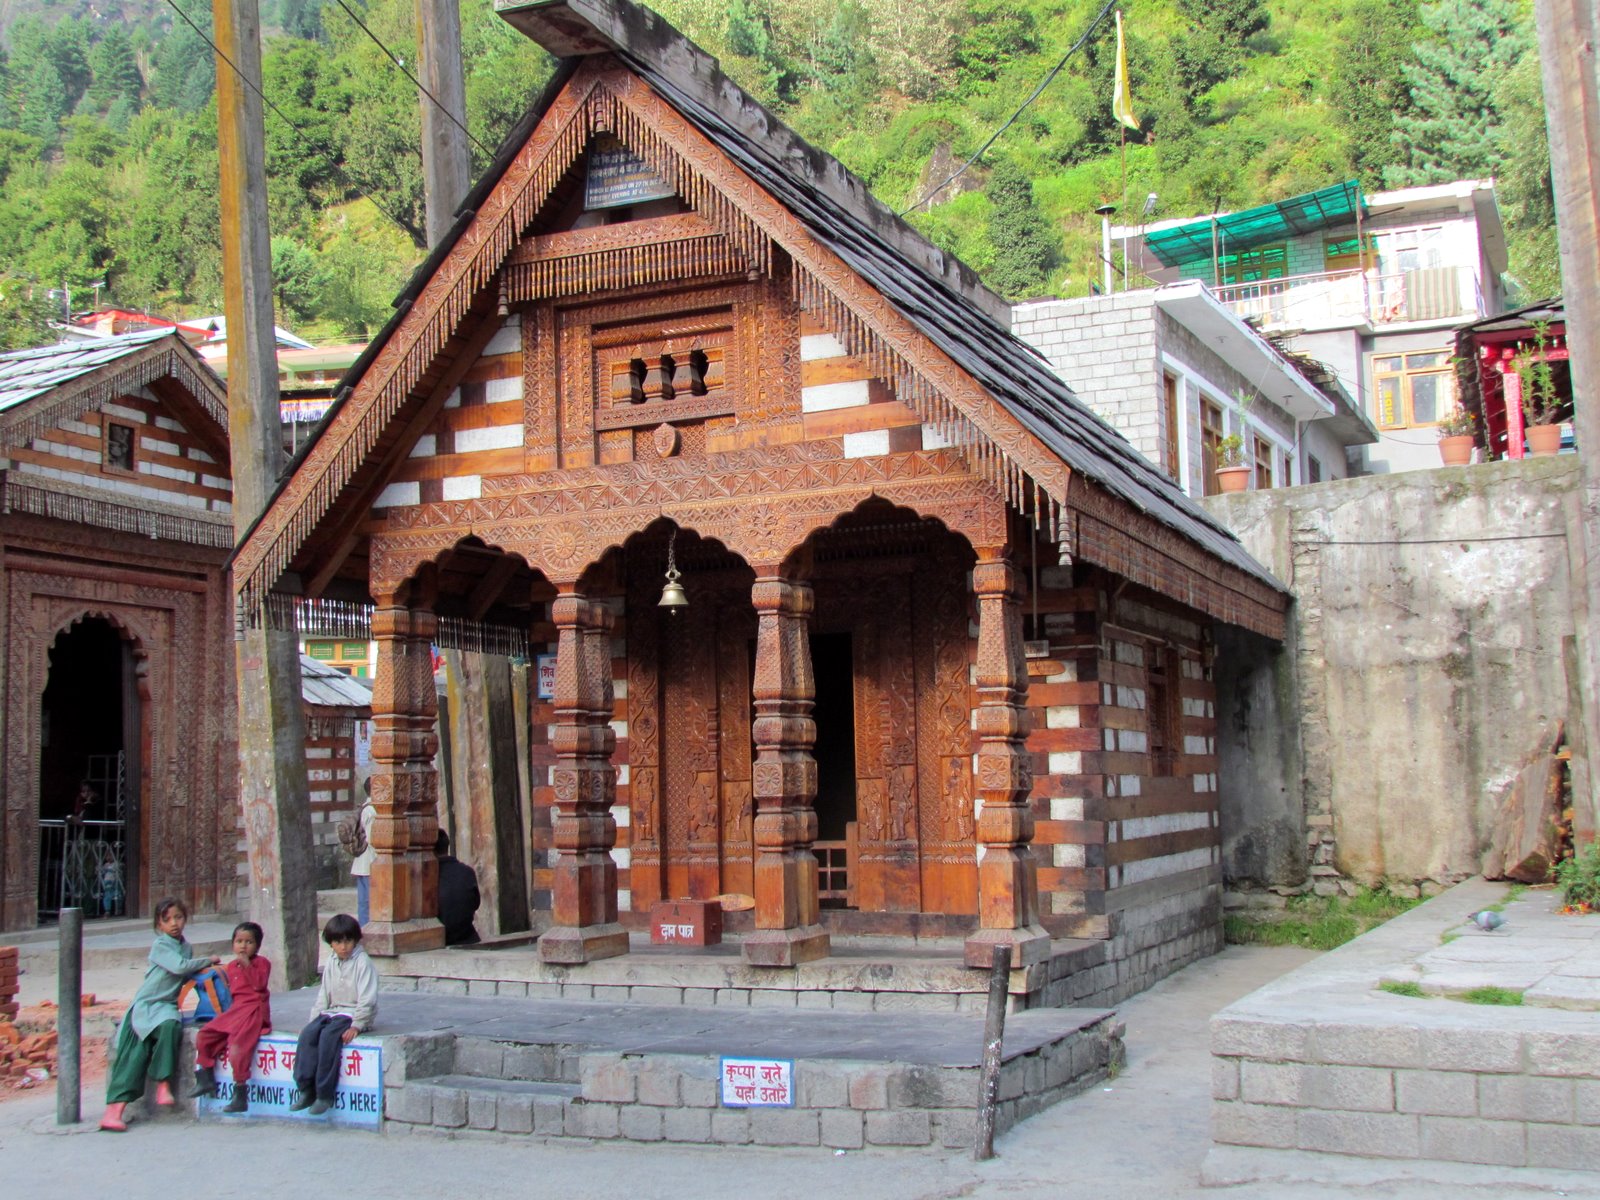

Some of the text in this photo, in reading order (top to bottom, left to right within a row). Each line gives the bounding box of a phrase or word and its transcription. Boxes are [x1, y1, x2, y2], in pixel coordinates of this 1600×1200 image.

[678, 925, 694, 938] पात्र
[257, 1044, 276, 1075] जूते
[345, 1050, 362, 1076] जी
[760, 1063, 782, 1084] जूते
[350, 1092, 377, 1112] HERE
